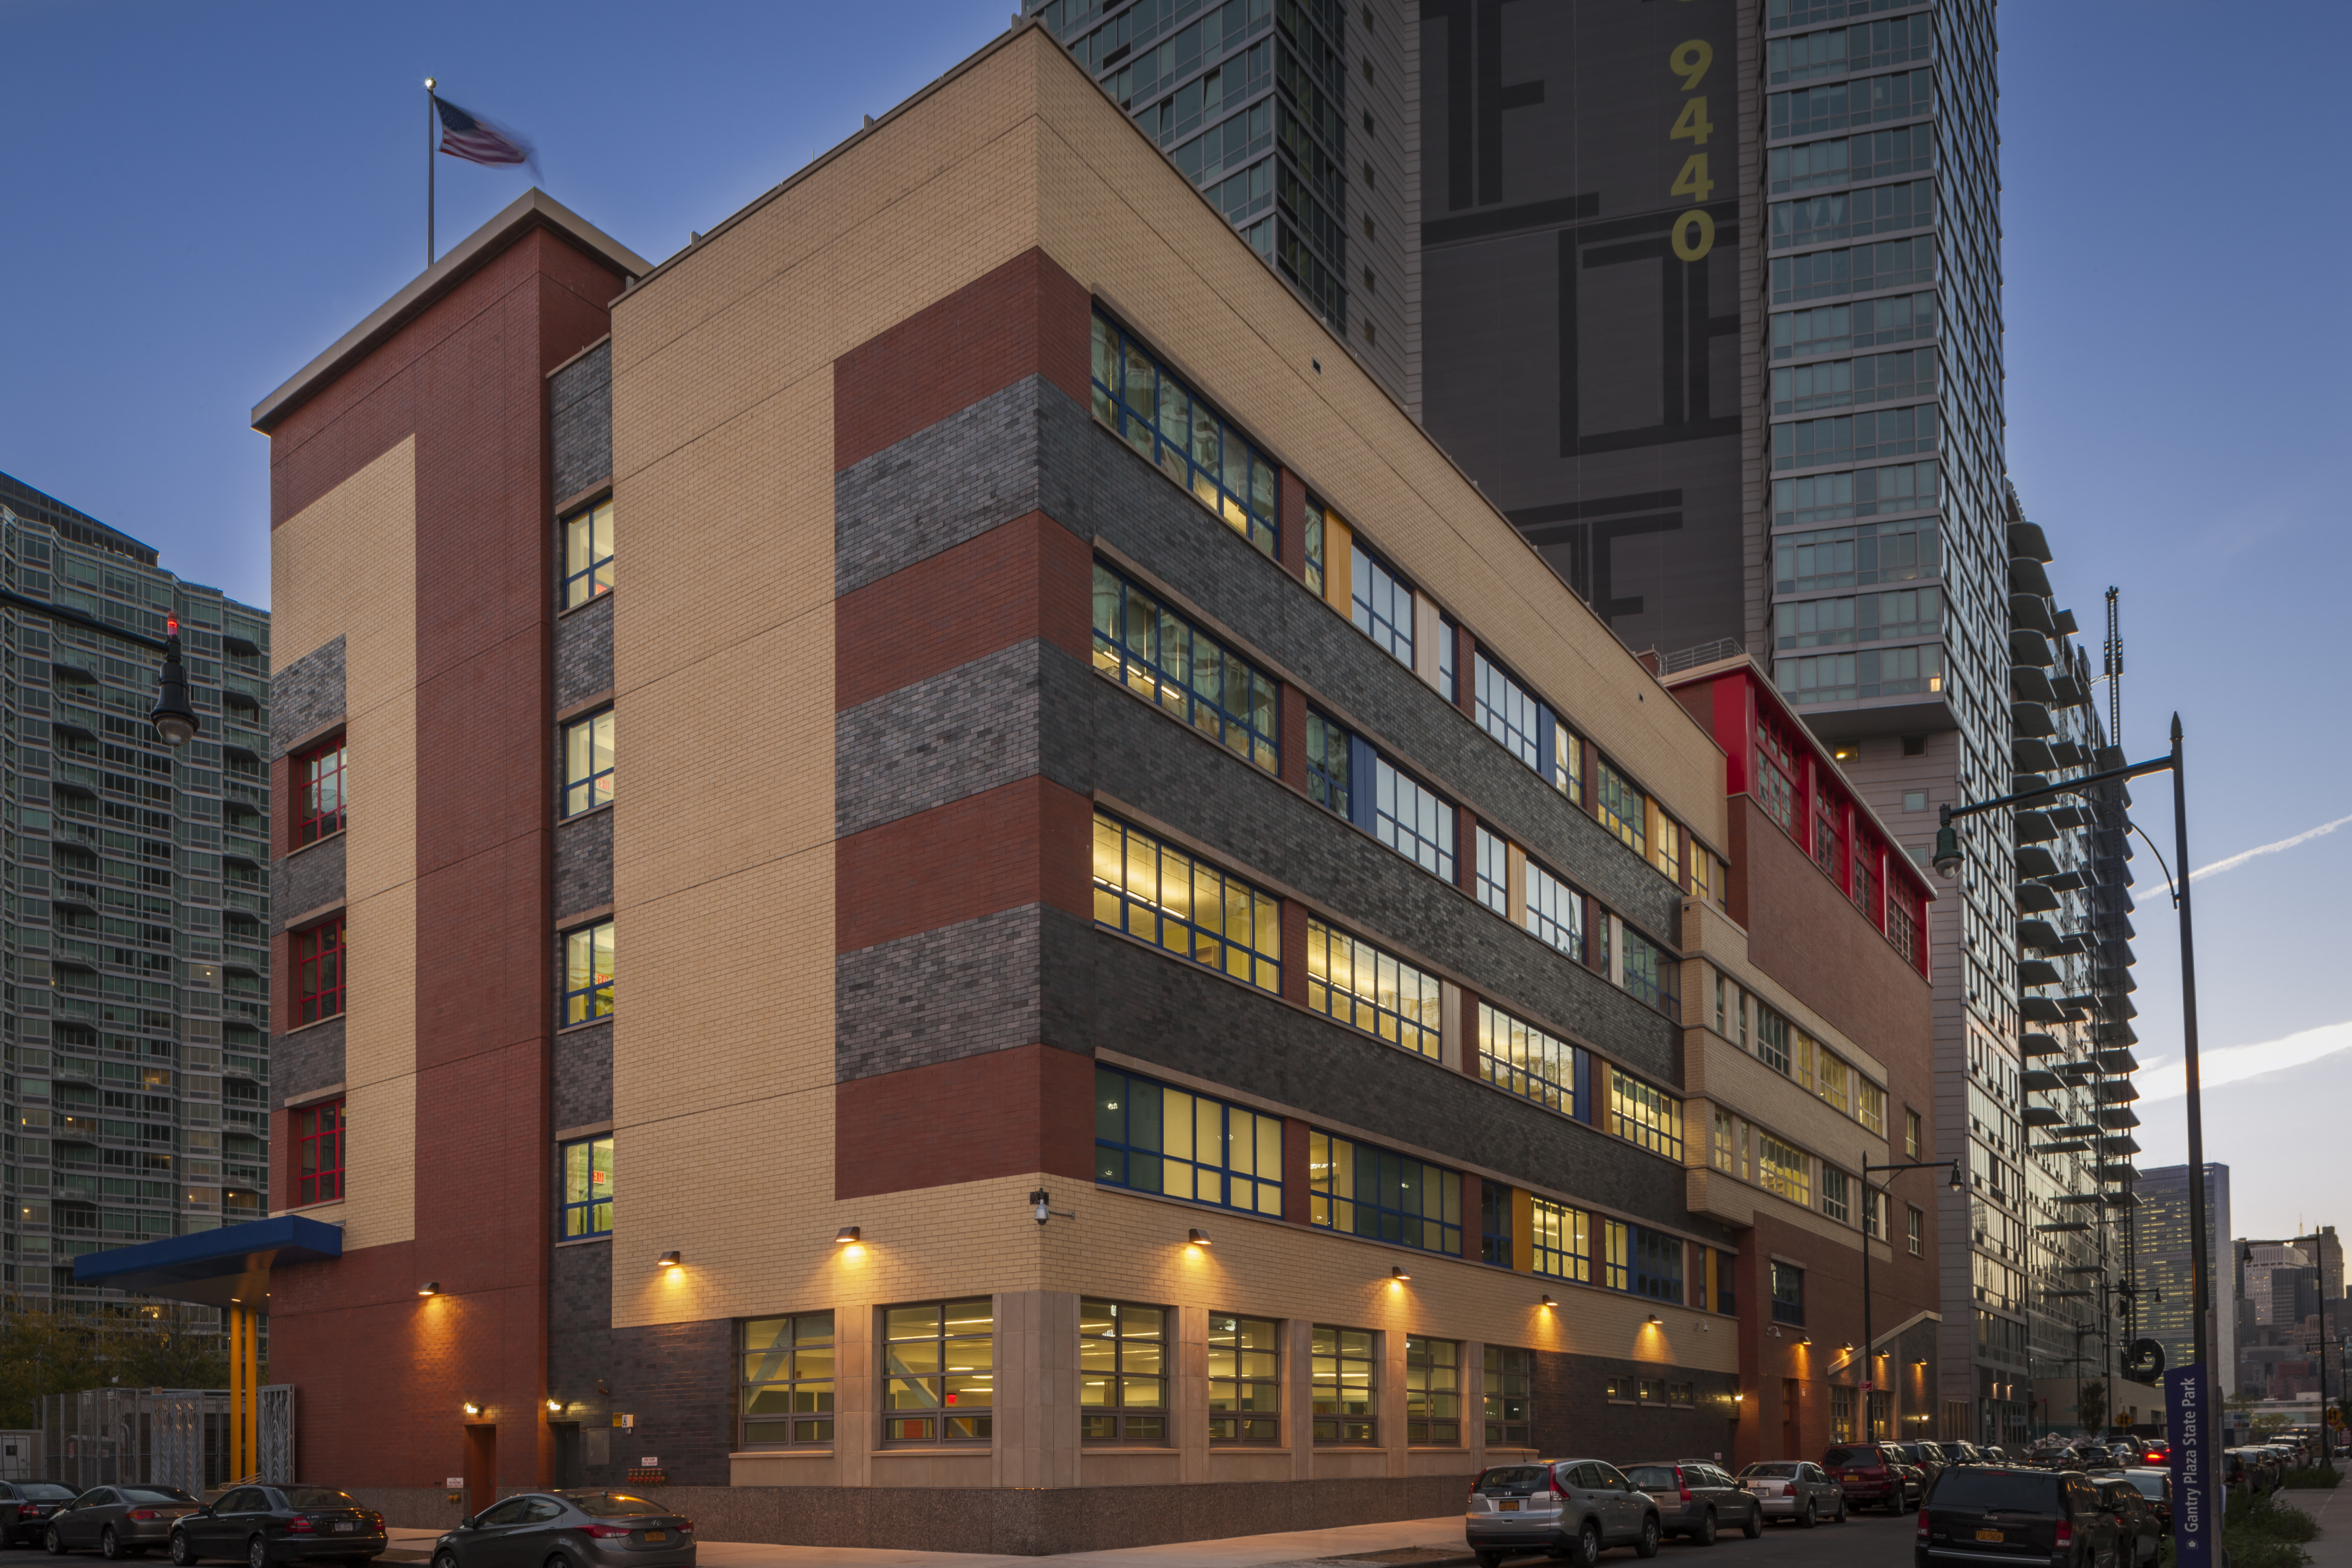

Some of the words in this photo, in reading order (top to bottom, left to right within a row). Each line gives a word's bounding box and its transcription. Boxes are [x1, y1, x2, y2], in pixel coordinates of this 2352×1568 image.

[599, 777, 610, 791] EXIT
[598, 973, 609, 984] EXIT
[593, 1171, 604, 1183] EXIT
[2180, 1378, 2195, 1407] Park
[2183, 1411, 2196, 1446] State
[2183, 1450, 2197, 1483] Plaza
[2184, 1488, 2201, 1532] Gantry
